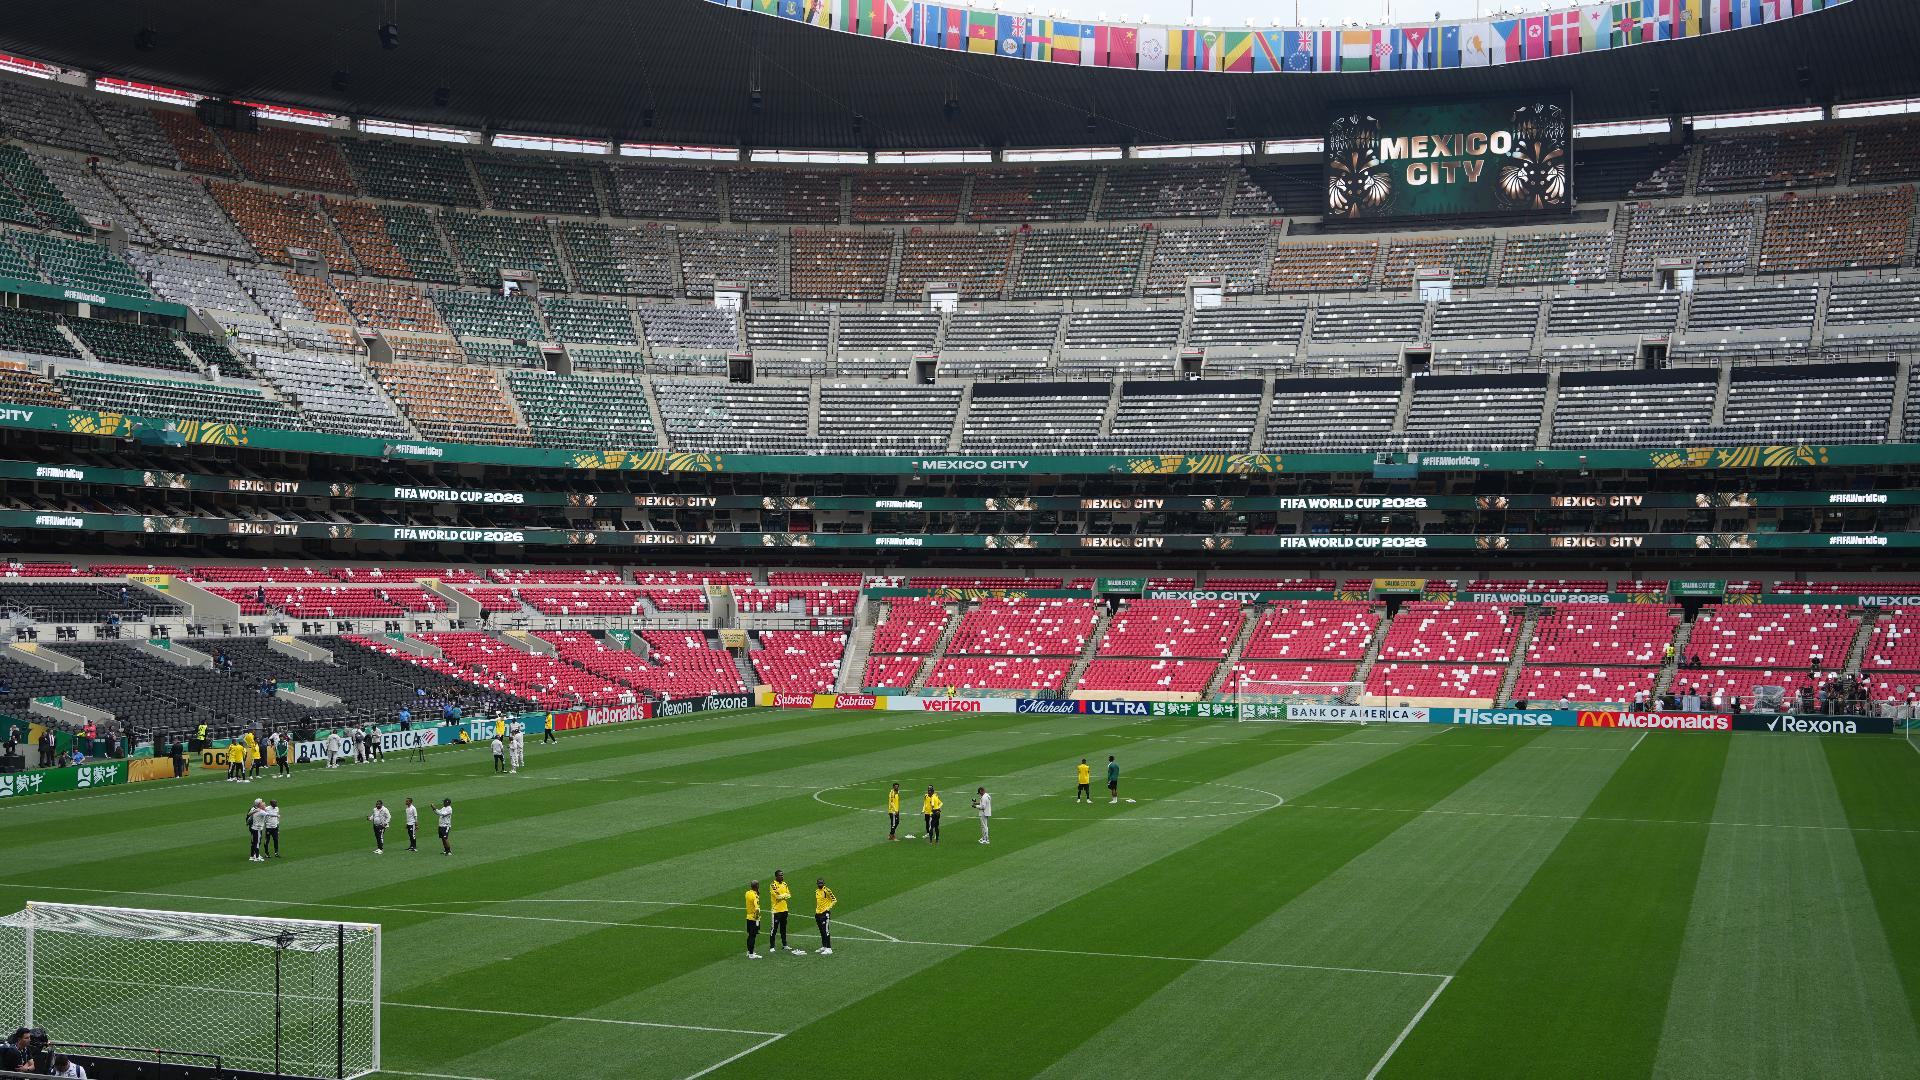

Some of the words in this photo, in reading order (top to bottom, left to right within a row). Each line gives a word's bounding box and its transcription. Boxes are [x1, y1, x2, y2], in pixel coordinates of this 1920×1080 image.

[1380, 131, 1512, 160] MEXICO
[1407, 160, 1484, 186] CITY
[64, 290, 106, 304] #FIFAWorldCup
[922, 460, 987, 470] MEXICO
[991, 460, 1029, 470] CITY
[1423, 456, 1480, 467] #FIFAWorldCup
[37, 467, 83, 480] #FIFAWorldCup
[229, 480, 272, 492] MEXICO
[274, 482, 299, 493] CITY
[395, 488, 417, 499] FIFA
[419, 489, 459, 501] WORLD
[460, 492, 482, 502] CUP
[484, 493, 524, 503] 2026
[634, 497, 684, 507] MEXICO
[687, 497, 717, 507] CITY
[1551, 496, 1607, 507] MEXICO
[1610, 495, 1643, 507] CITY
[1830, 493, 1888, 504] #FIFAWorldCup
[1080, 498, 1132, 509] MEXICO
[1134, 498, 1164, 509] CITY
[1280, 498, 1307, 509] FIFA
[1308, 498, 1354, 509] WORLD
[1355, 498, 1381, 509] CUP
[1382, 498, 1428, 509] 2026
[36, 516, 83, 528] #FIFAWorldCup
[229, 522, 271, 534] MEXICO
[274, 524, 299, 535] CITY
[394, 528, 417, 539] FIFA
[419, 530, 459, 541] WORLD
[460, 531, 482, 541] CUP
[484, 532, 524, 542] 2026
[634, 534, 684, 544] MEXICO
[687, 534, 717, 545] CITY
[1280, 536, 1307, 547] FIFA
[1308, 536, 1354, 547] WORLD
[1355, 536, 1381, 547] CUP
[1382, 536, 1428, 547] 2026
[1830, 535, 1888, 546] #FIFAWorldCup
[1080, 537, 1132, 547] MEXICO
[1134, 537, 1164, 547] CITY
[1551, 536, 1607, 547] MEXICO
[1610, 536, 1643, 548] CITY
[1151, 591, 1218, 601] MEXICO
[1221, 592, 1261, 602] CITY
[1473, 594, 1498, 603] FIFA
[1498, 594, 1542, 603] WORLD
[1543, 594, 1567, 603] CUP
[1568, 594, 1609, 604] 2026
[708, 696, 748, 711] Rexona
[775, 694, 812, 706] Sabritas
[836, 695, 874, 708] Sabritas
[923, 698, 981, 712] verizon
[1019, 699, 1074, 713] Michelob
[1091, 702, 1147, 714] ULTRA
[662, 700, 693, 716] Rexona
[1292, 708, 1326, 717] BANK
[1331, 708, 1346, 718] OF
[1350, 709, 1409, 719] AMERICA
[586, 703, 644, 727] McDonald's
[1453, 709, 1552, 725] Hisense
[1617, 713, 1729, 729] McDonald's
[1782, 716, 1857, 734] Rexona
[301, 741, 328, 758] BAN
[92, 765, 118, 784] 蒙牛
[16, 773, 44, 793] 蒙牛
